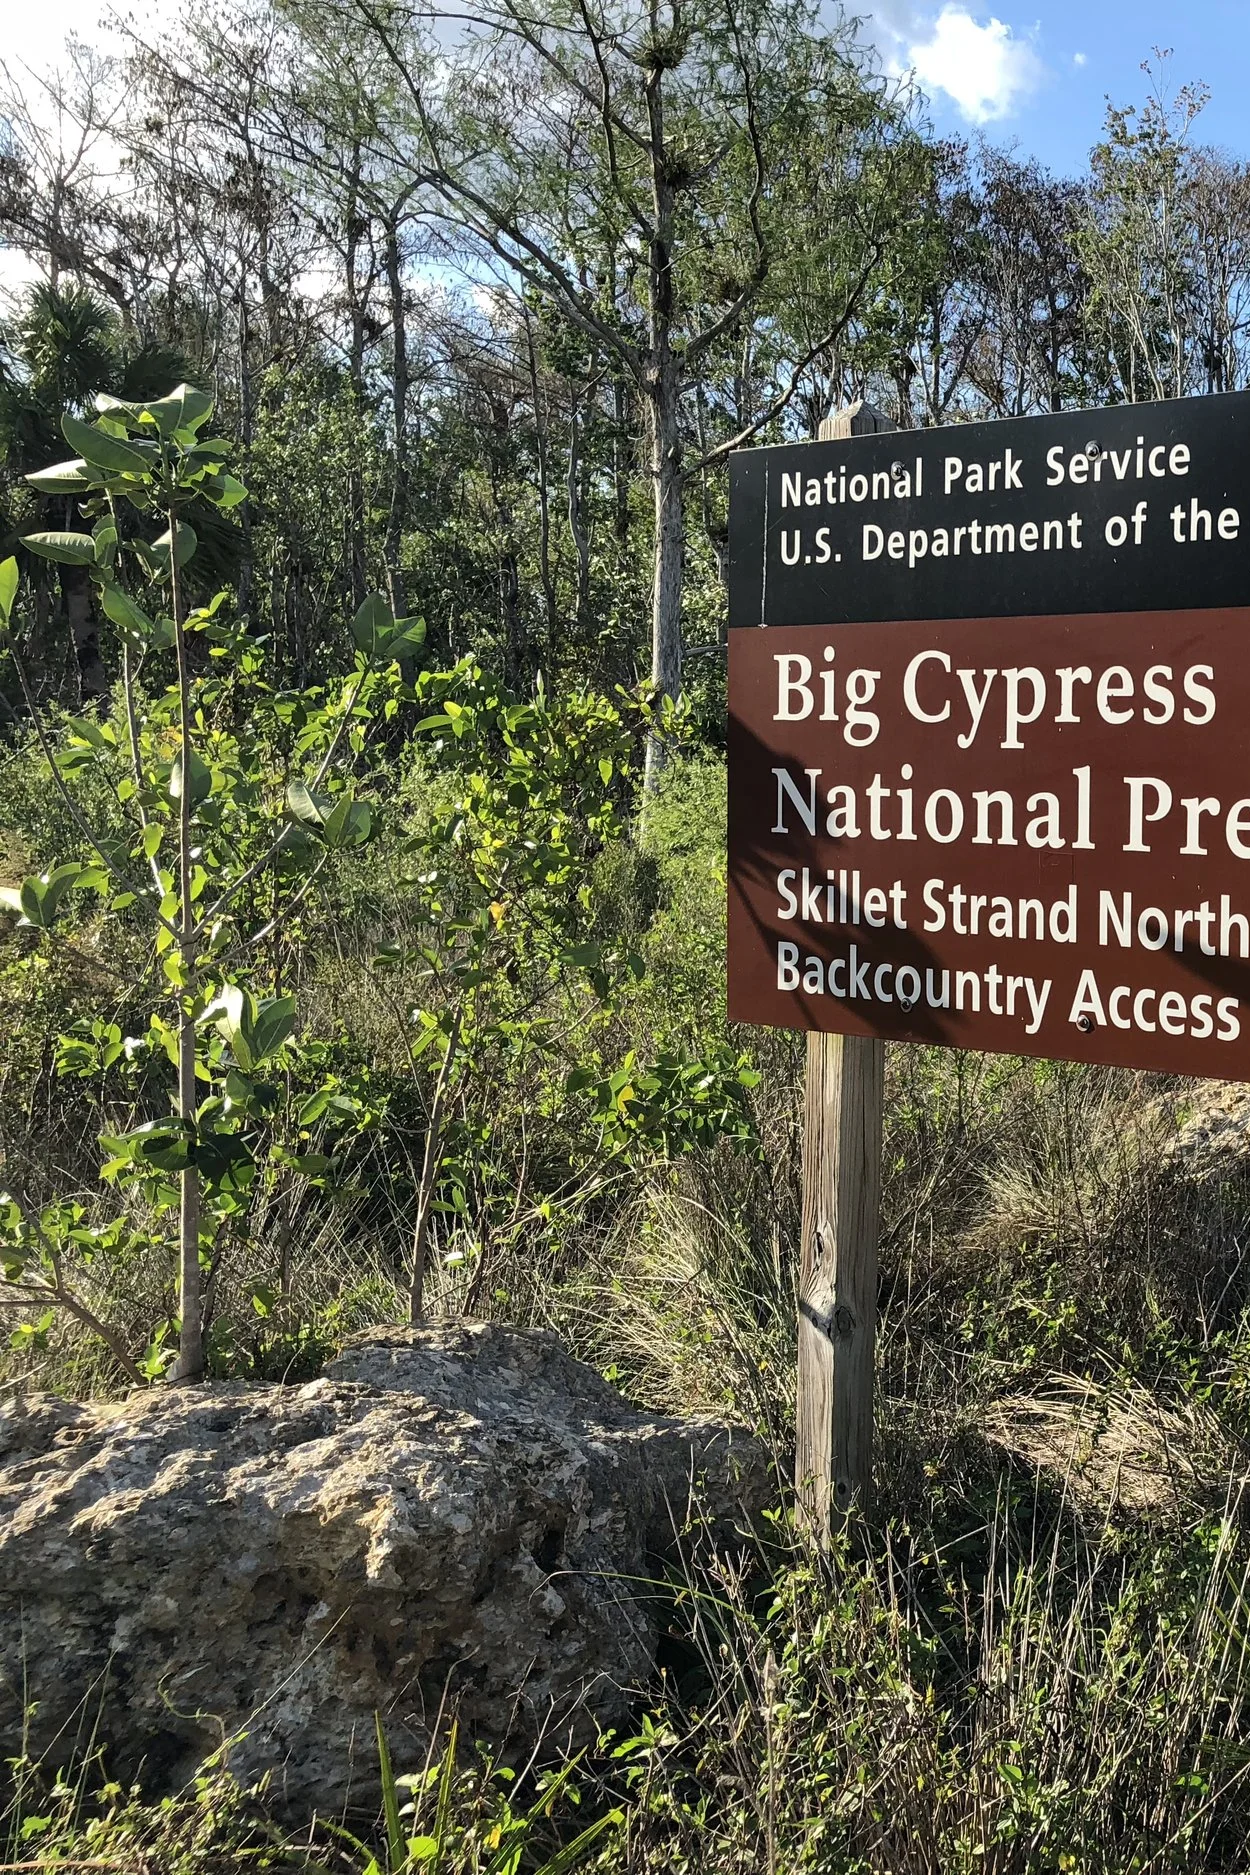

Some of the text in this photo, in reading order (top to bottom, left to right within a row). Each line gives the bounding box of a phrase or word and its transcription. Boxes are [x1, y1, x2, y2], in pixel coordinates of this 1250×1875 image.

[782, 436, 1190, 507] National Park Service
[781, 527, 841, 565] U.S.
[863, 512, 1082, 568] Department
[1105, 501, 1147, 546] of
[1170, 498, 1239, 542] the
[773, 646, 1216, 749] Big Cypress
[772, 764, 1095, 849] National
[777, 867, 1249, 958] Skillet Strand North
[777, 941, 1053, 1035] Backcountry
[1068, 969, 1240, 1041] Access
